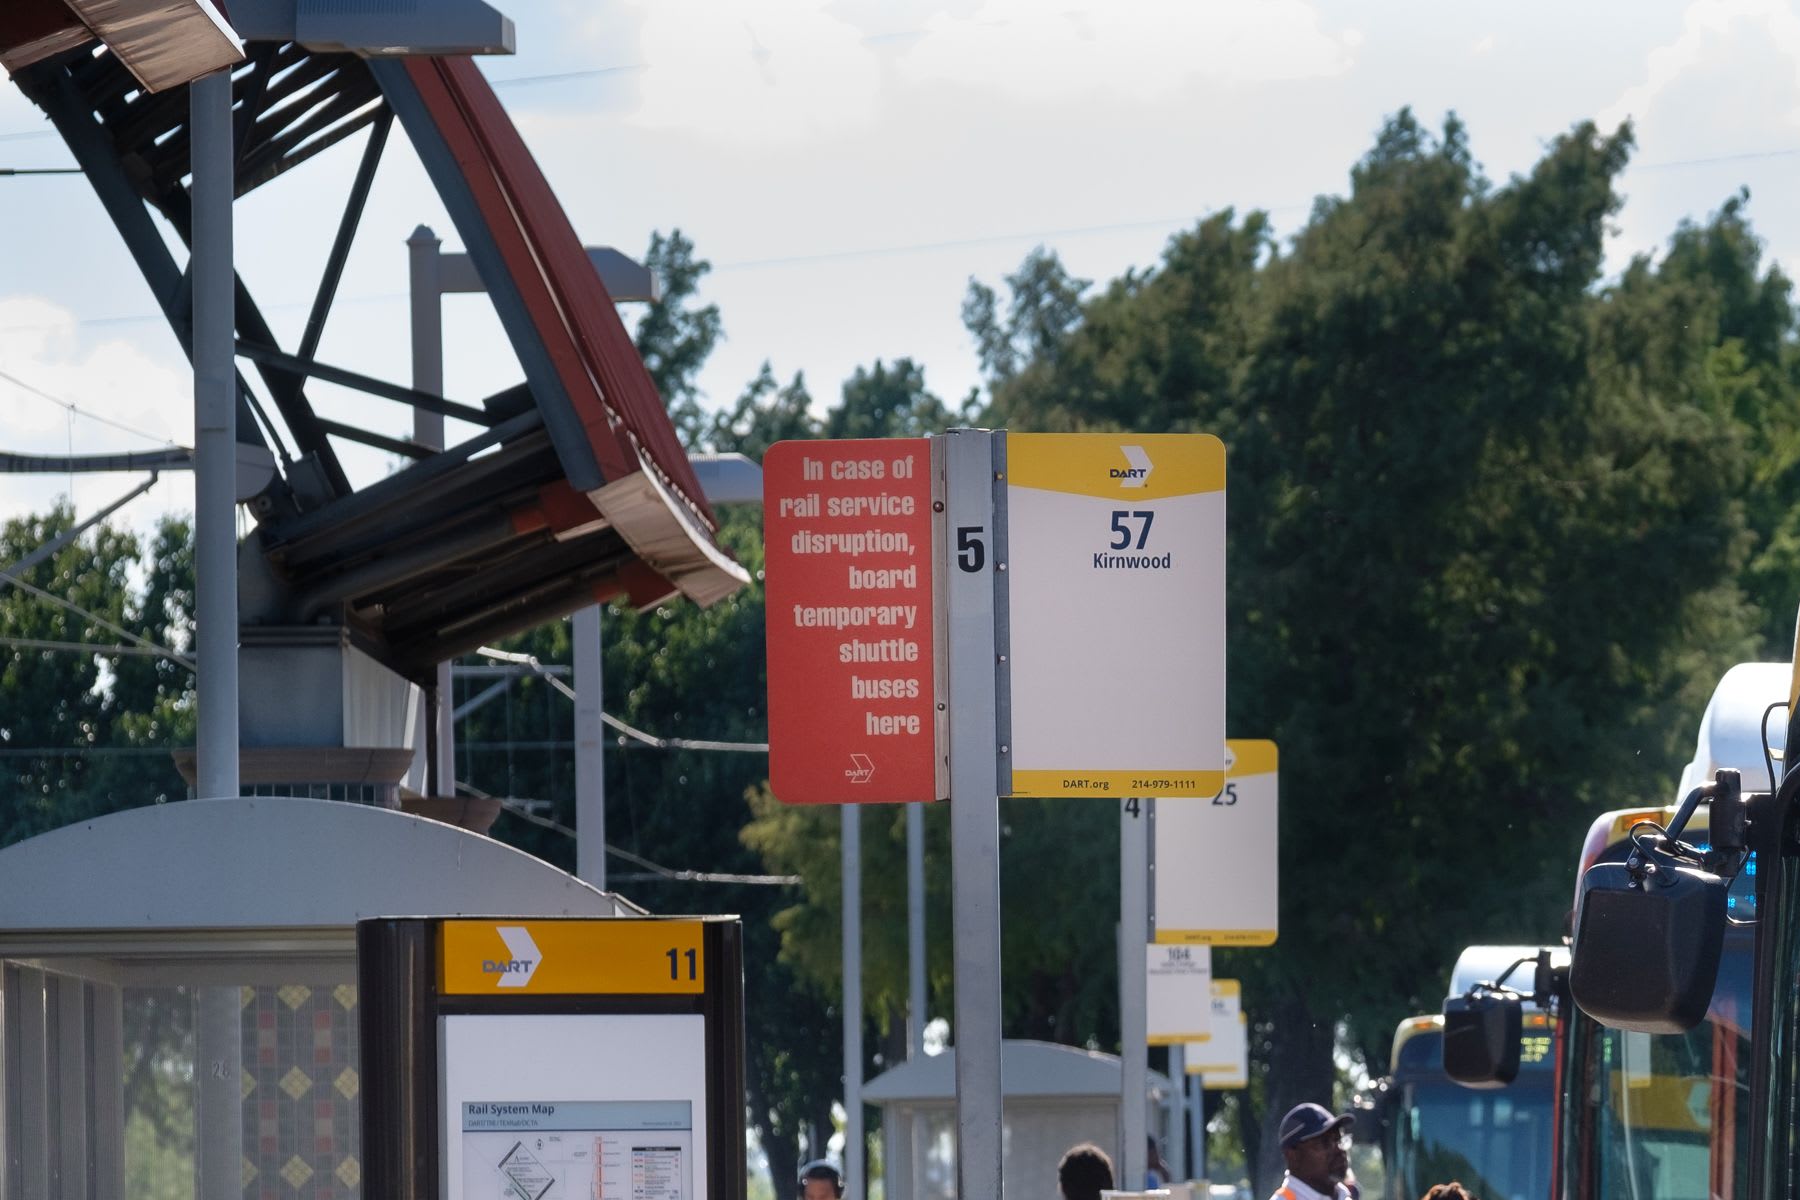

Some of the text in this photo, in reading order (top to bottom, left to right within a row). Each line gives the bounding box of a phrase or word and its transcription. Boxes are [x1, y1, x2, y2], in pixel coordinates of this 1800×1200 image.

[803, 455, 914, 481] In case of
[1109, 468, 1147, 479] DART
[780, 492, 915, 518] rail service
[1110, 510, 1155, 550] 57
[791, 529, 915, 557] disruption,
[957, 526, 985, 573] 5
[1093, 552, 1172, 569] Kirnwood
[849, 565, 917, 590] board
[793, 604, 917, 630] temporary
[839, 638, 919, 663] shuttle
[851, 675, 919, 699] buses
[866, 711, 920, 736] here
[845, 769, 870, 777] DART
[1062, 779, 1196, 791] DART.org 214-979-1111
[482, 947, 697, 981] DART 11
[468, 1103, 555, 1119] Rail System Map
